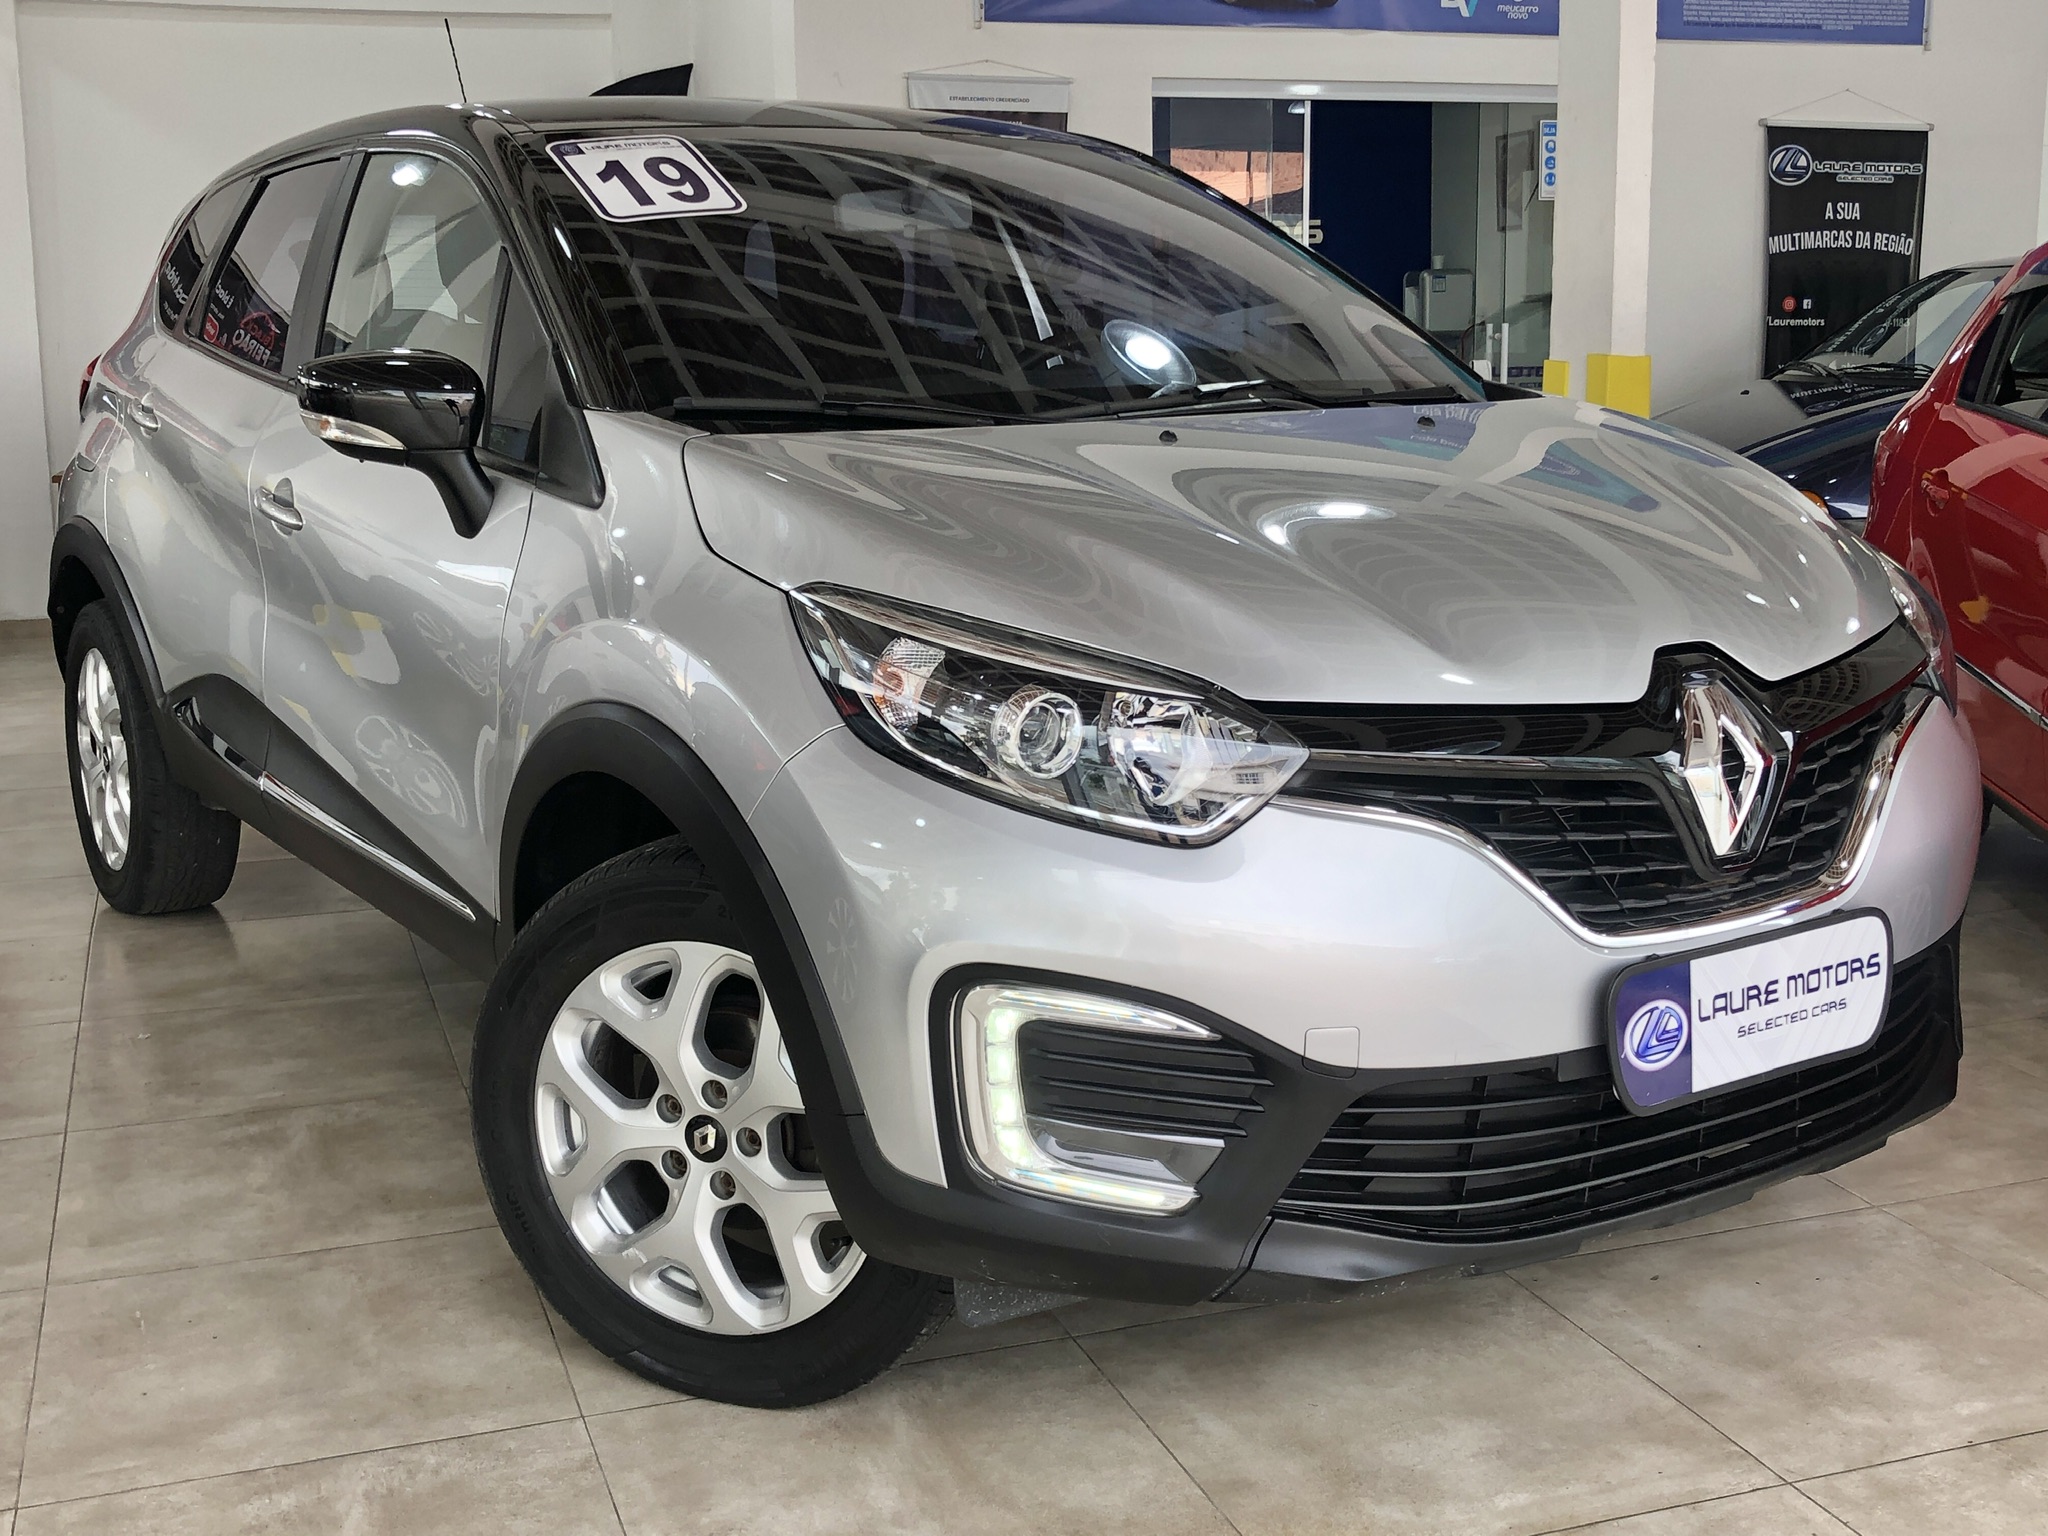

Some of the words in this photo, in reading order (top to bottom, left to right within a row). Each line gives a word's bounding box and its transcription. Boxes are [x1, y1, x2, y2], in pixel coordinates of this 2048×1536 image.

[1507, 12, 1529, 20] novo
[1814, 161, 1862, 173] LAURE
[1864, 162, 1923, 175] MOTORS
[596, 156, 710, 207] 19
[1825, 202, 1833, 220] A
[1836, 202, 1861, 220] SUA
[1769, 230, 1853, 256] MULTIMARCAS
[1855, 231, 1871, 250] DA
[1873, 233, 1914, 256] REGIÃO
[1697, 979, 1780, 1022] LAURE
[1786, 952, 1881, 1000] MOTORS
[1737, 1009, 1809, 1038] SELECTED
[1812, 998, 1848, 1018] CARS
